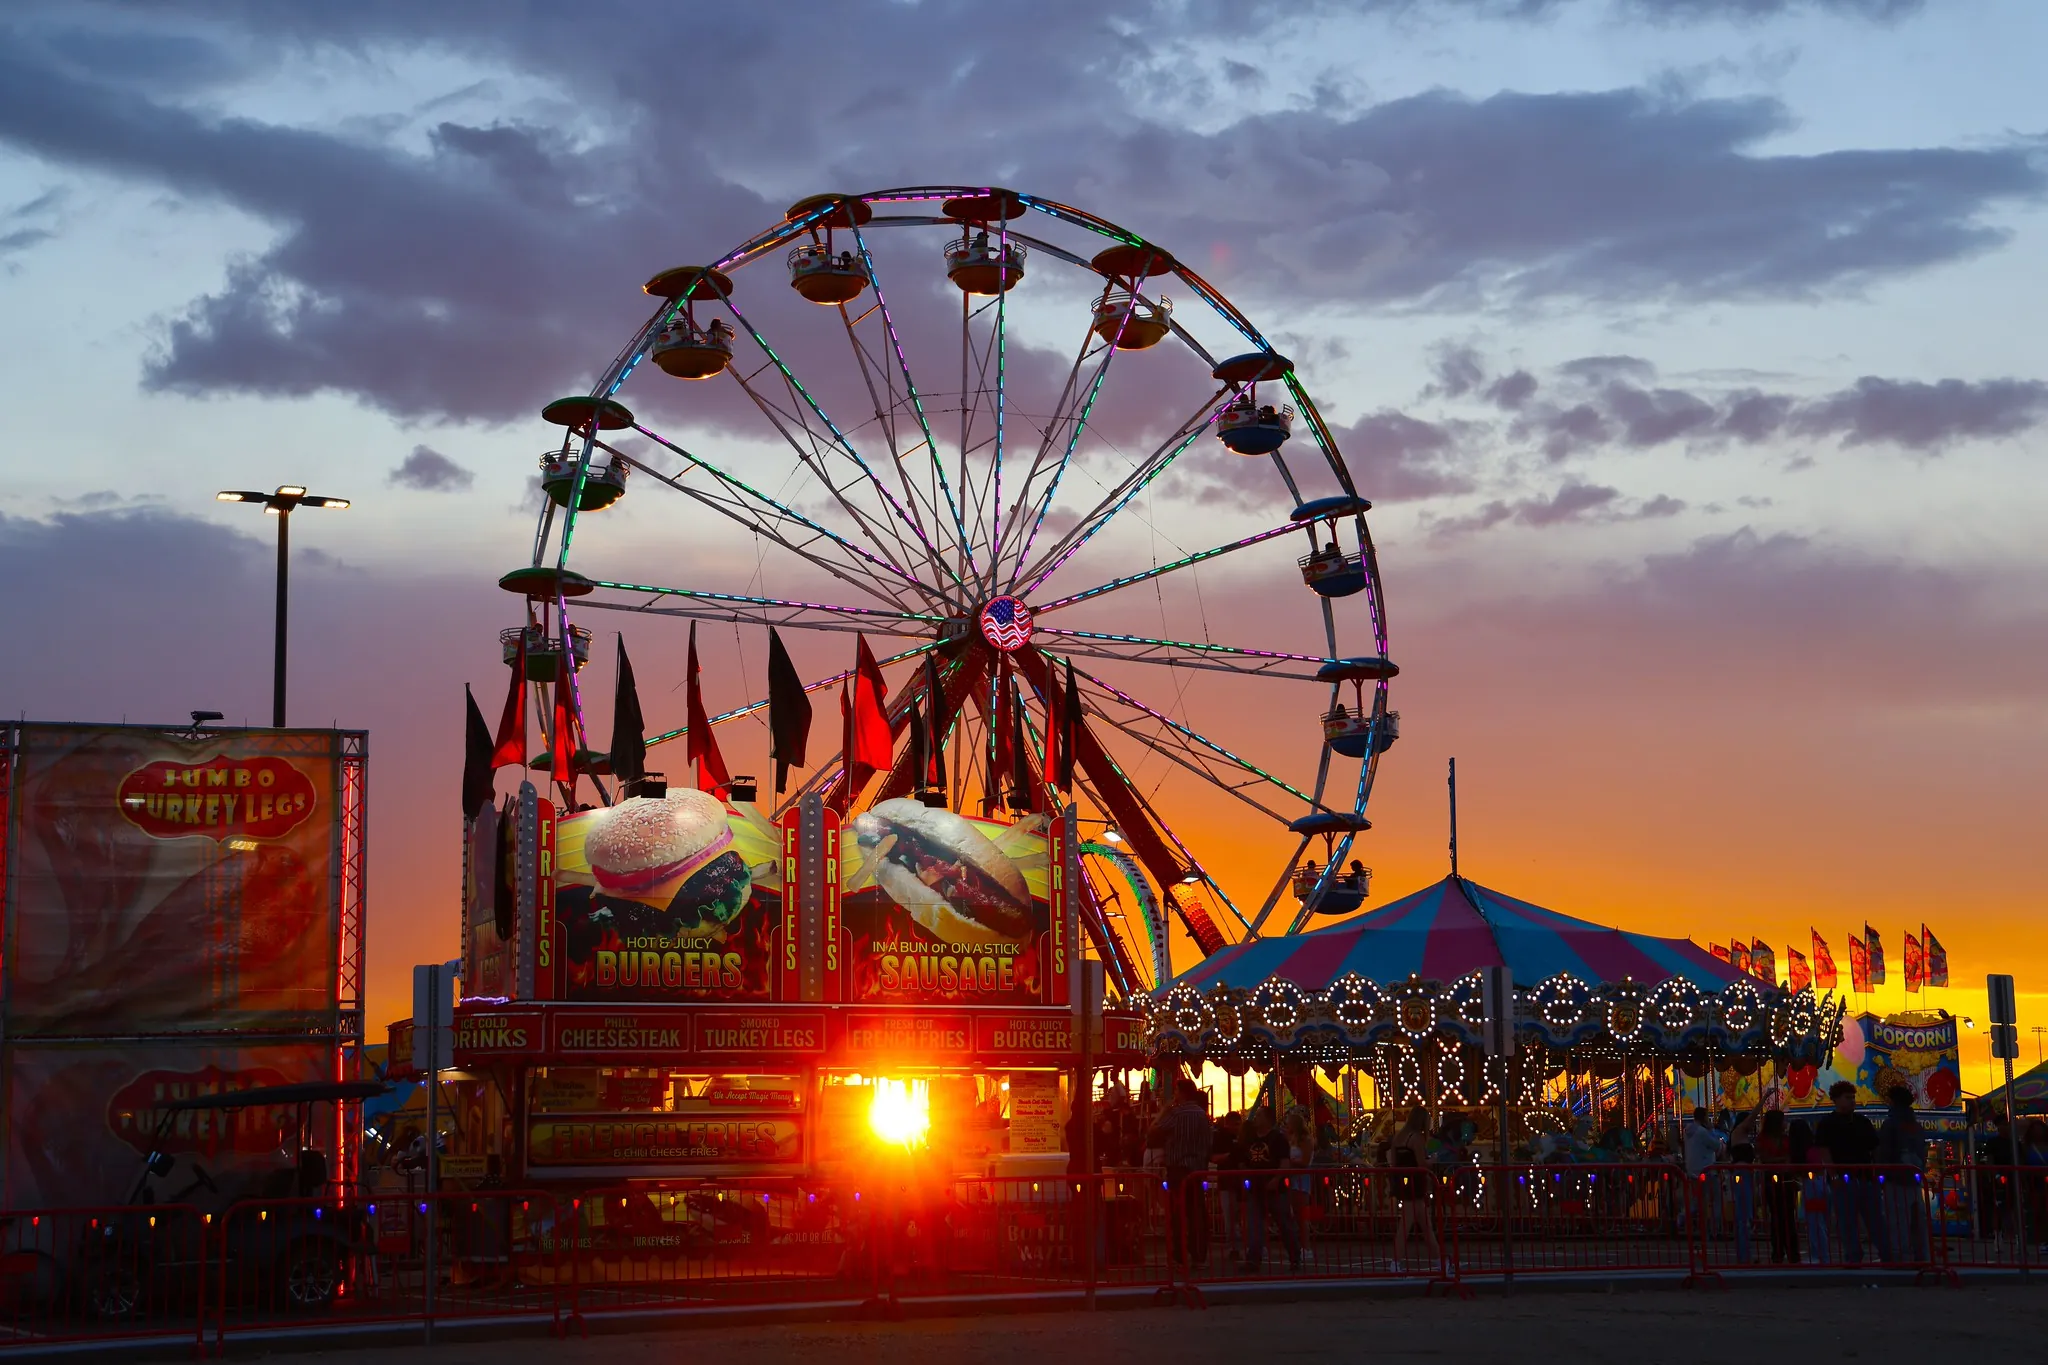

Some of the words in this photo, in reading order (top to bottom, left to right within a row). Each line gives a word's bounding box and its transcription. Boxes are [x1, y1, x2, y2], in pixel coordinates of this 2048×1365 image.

[163, 768, 275, 787] JUMBO
[128, 793, 239, 825] TURKEY
[245, 793, 305, 823] LEGS
[540, 819, 552, 967] FRIES
[786, 828, 797, 970] FRIES
[826, 829, 837, 971] FRIES
[1053, 837, 1065, 974] FRIES
[627, 937, 656, 949] HOT
[659, 937, 670, 949] &
[673, 937, 712, 949] JUICY
[873, 941, 886, 953] IN
[888, 941, 898, 953] A
[900, 941, 928, 953] BUN
[931, 943, 946, 954] or
[951, 942, 970, 954] ON
[973, 943, 983, 954] A
[985, 943, 1020, 955] STICK
[596, 950, 742, 988] BURGERS
[881, 955, 1014, 991] SAUSAGE
[460, 1018, 475, 1030] ICE
[478, 1017, 508, 1029] COLD
[604, 1018, 638, 1029] PHILLY
[740, 1018, 780, 1029] SMOKED
[884, 1019, 915, 1030] FRESH
[916, 1019, 934, 1030] CUT
[1009, 1020, 1027, 1031] HOT
[1030, 1020, 1036, 1031] &
[1038, 1020, 1063, 1031] JUICY
[561, 1028, 681, 1048] CHEESESTEAK
[705, 1029, 769, 1048] TURKEY
[773, 1029, 815, 1048] LEGS
[853, 1031, 918, 1049] FRENCH
[920, 1031, 965, 1049] FRIES
[993, 1031, 1073, 1049] BURGER
[1873, 1024, 1952, 1048] POPCORN!
[713, 1091, 724, 1100] We
[725, 1091, 748, 1102] Accept
[747, 1091, 769, 1103] Magic
[770, 1092, 793, 1104] Money
[552, 1123, 678, 1159] FRENCH
[688, 1121, 777, 1156] FRIES
[613, 1148, 622, 1158] &
[649, 1147, 688, 1157] CHEESE
[690, 1147, 718, 1157] FRIES
